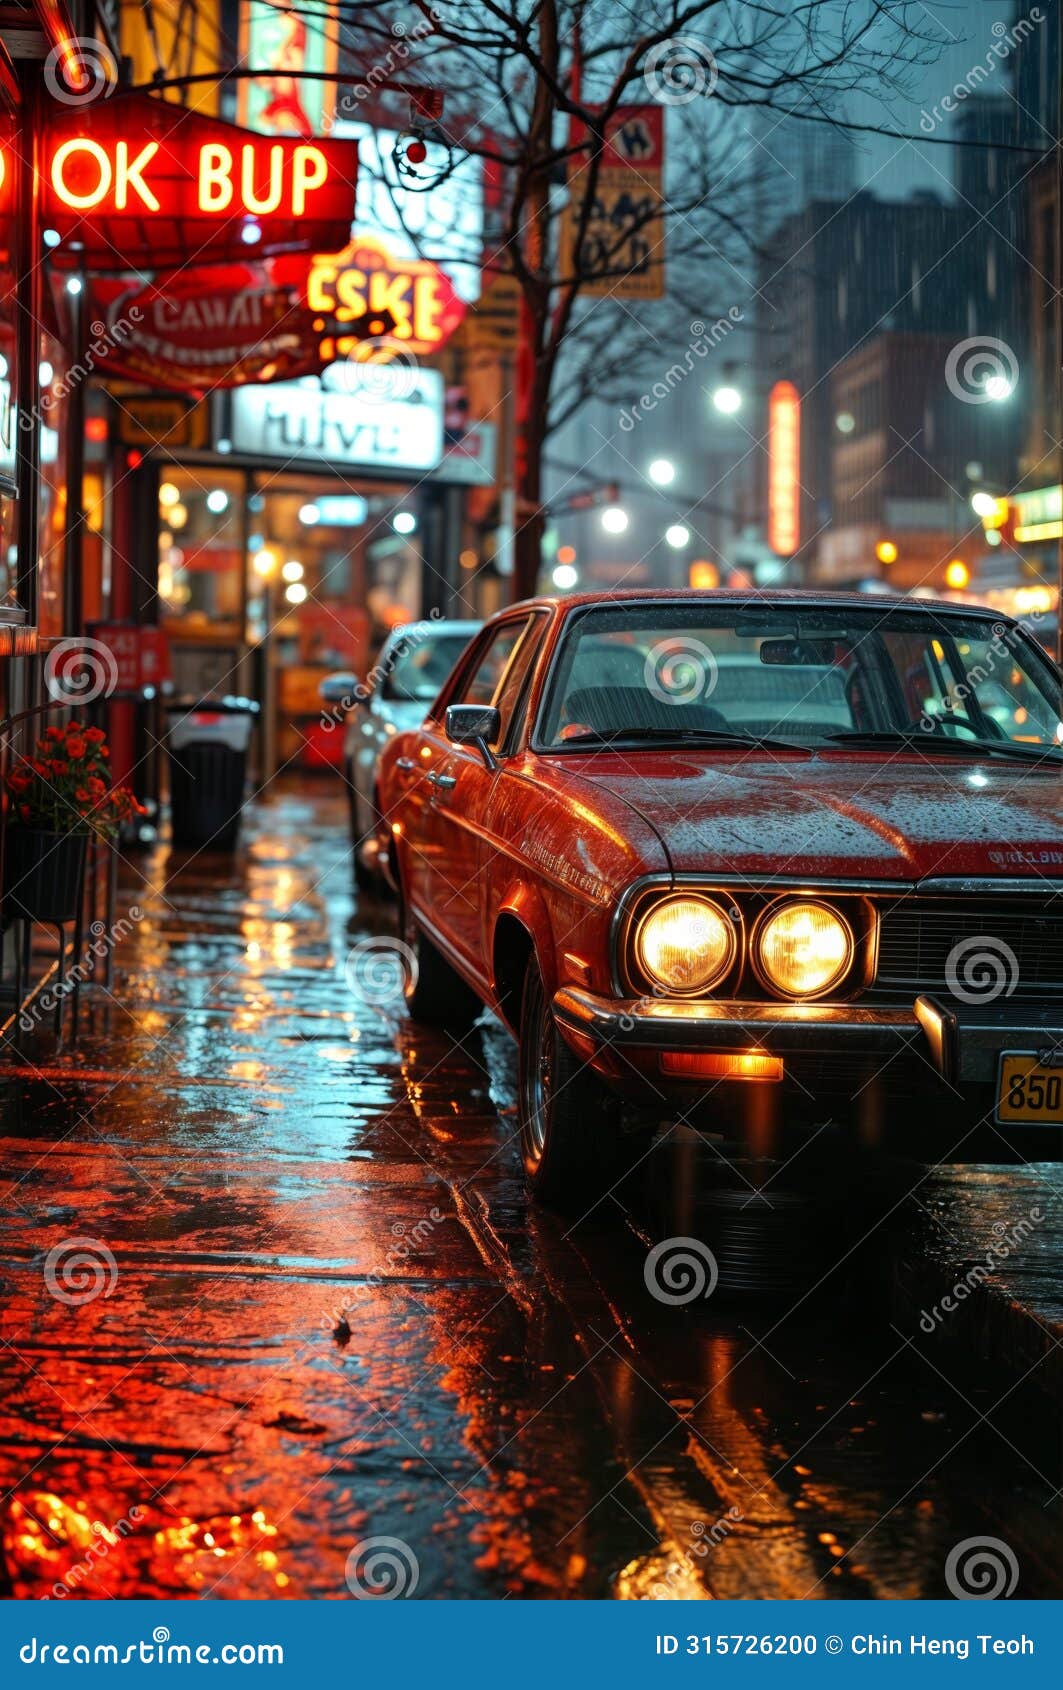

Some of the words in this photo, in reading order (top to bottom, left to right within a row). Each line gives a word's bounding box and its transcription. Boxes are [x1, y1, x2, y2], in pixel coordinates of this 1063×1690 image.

[51, 138, 160, 211] OK
[199, 143, 328, 216] BUP
[1008, 1073, 1062, 1111] 850
